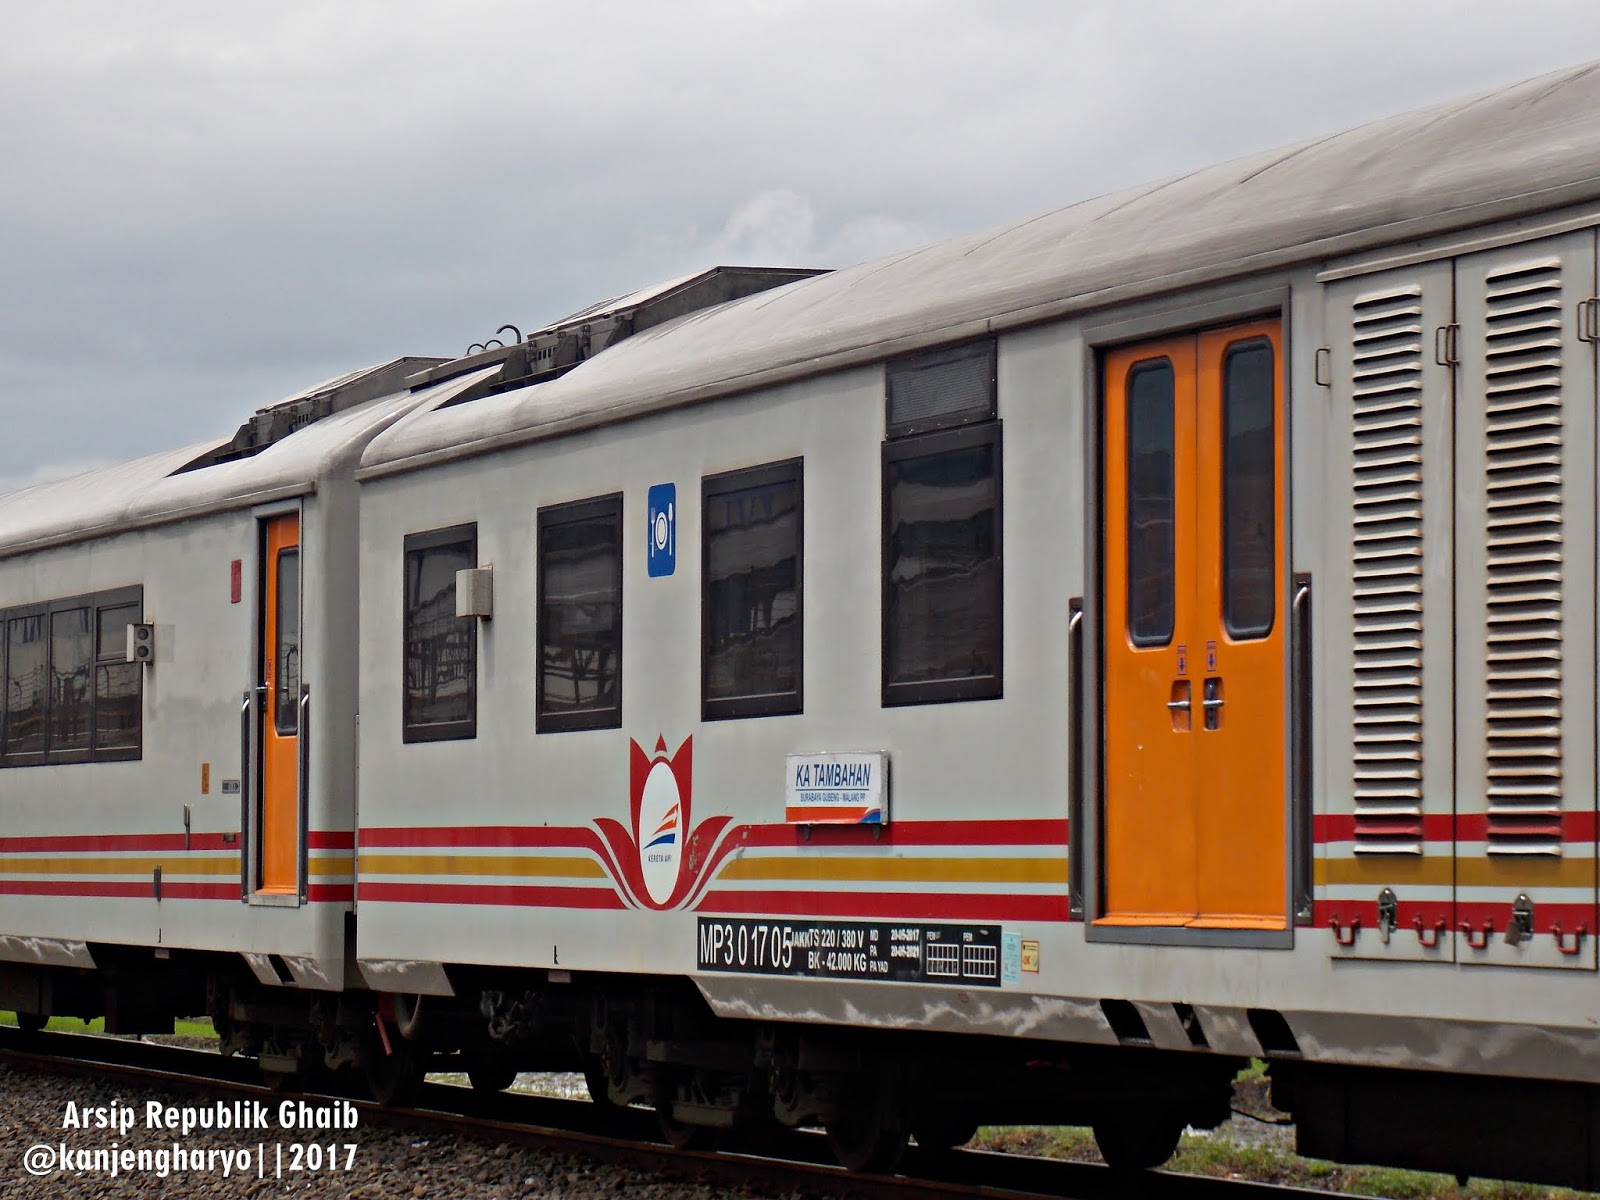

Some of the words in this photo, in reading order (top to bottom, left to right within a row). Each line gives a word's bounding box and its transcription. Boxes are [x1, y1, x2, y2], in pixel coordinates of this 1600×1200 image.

[796, 764, 810, 787] KA
[813, 763, 871, 787] TAMBAHAN
[800, 793, 821, 802] SURABAYA
[822, 793, 840, 802] GUBENG
[843, 793, 859, 802] MALANG
[648, 854, 664, 863] KERETA
[664, 854, 672, 863] API
[700, 924, 734, 965] MP3
[771, 926, 793, 968] 05
[821, 929, 836, 948] 220
[841, 930, 856, 948] 380
[857, 930, 864, 949] V
[869, 945, 878, 957] PA
[808, 951, 820, 970] BK
[826, 952, 852, 971] 42.000
[853, 953, 867, 972] KG
[869, 961, 877, 972] PA
